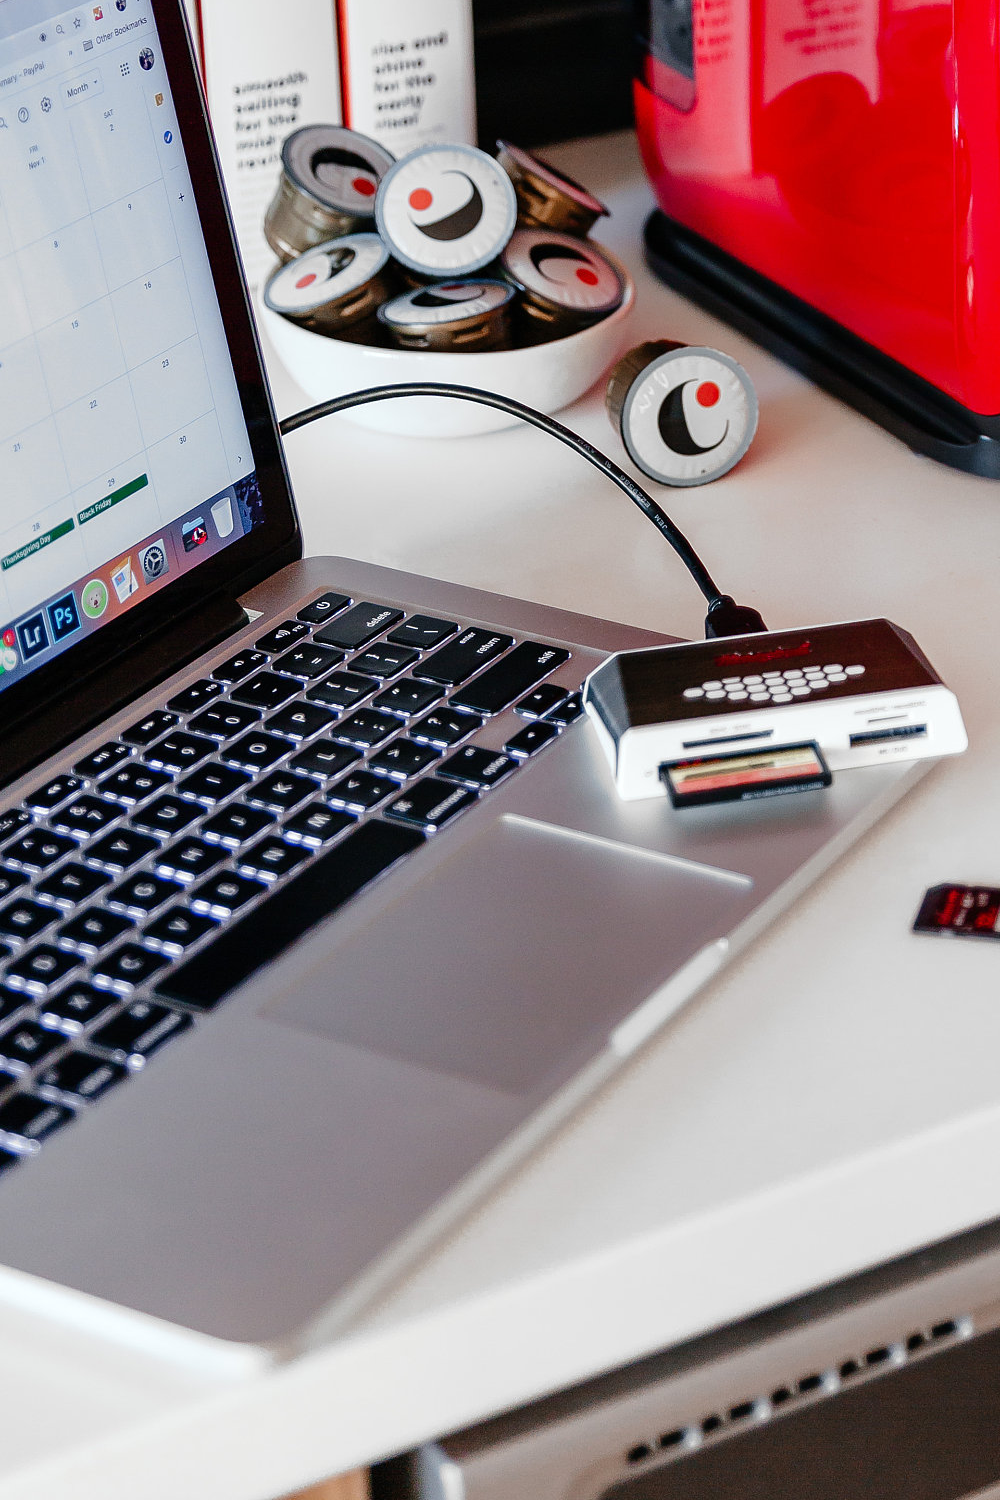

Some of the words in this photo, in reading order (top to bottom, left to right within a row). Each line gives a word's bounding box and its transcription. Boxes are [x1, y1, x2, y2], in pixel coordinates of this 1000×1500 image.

[95, 31, 114, 45] Other
[114, 17, 148, 36] Bookmarks
[23, 61, 45, 77] PayPal
[67, 82, 89, 98] Month
[103, 108, 114, 119] SAT
[109, 123, 115, 132] 2
[28, 159, 41, 171] Nov
[127, 203, 133, 212] 9
[144, 281, 152, 290] 16
[71, 319, 79, 330] 15
[161, 358, 170, 369] 23
[89, 399, 98, 410] 22
[178, 435, 188, 445] 30
[107, 476, 116, 488] 29
[79, 506, 95, 522] Black
[94, 497, 112, 516] Friday
[653, 513, 669, 530] JEM
[2, 541, 40, 568] Thanksgiving
[40, 533, 52, 546] Day
[54, 607, 73, 630] Ps
[366, 610, 393, 629] delete
[24, 626, 41, 649] Lr
[458, 630, 477, 645] enter
[475, 636, 501, 656] return
[536, 650, 557, 665] shift
[291, 712, 306, 723] P
[271, 781, 293, 795] K
[156, 807, 179, 819] U
[307, 812, 332, 828] M
